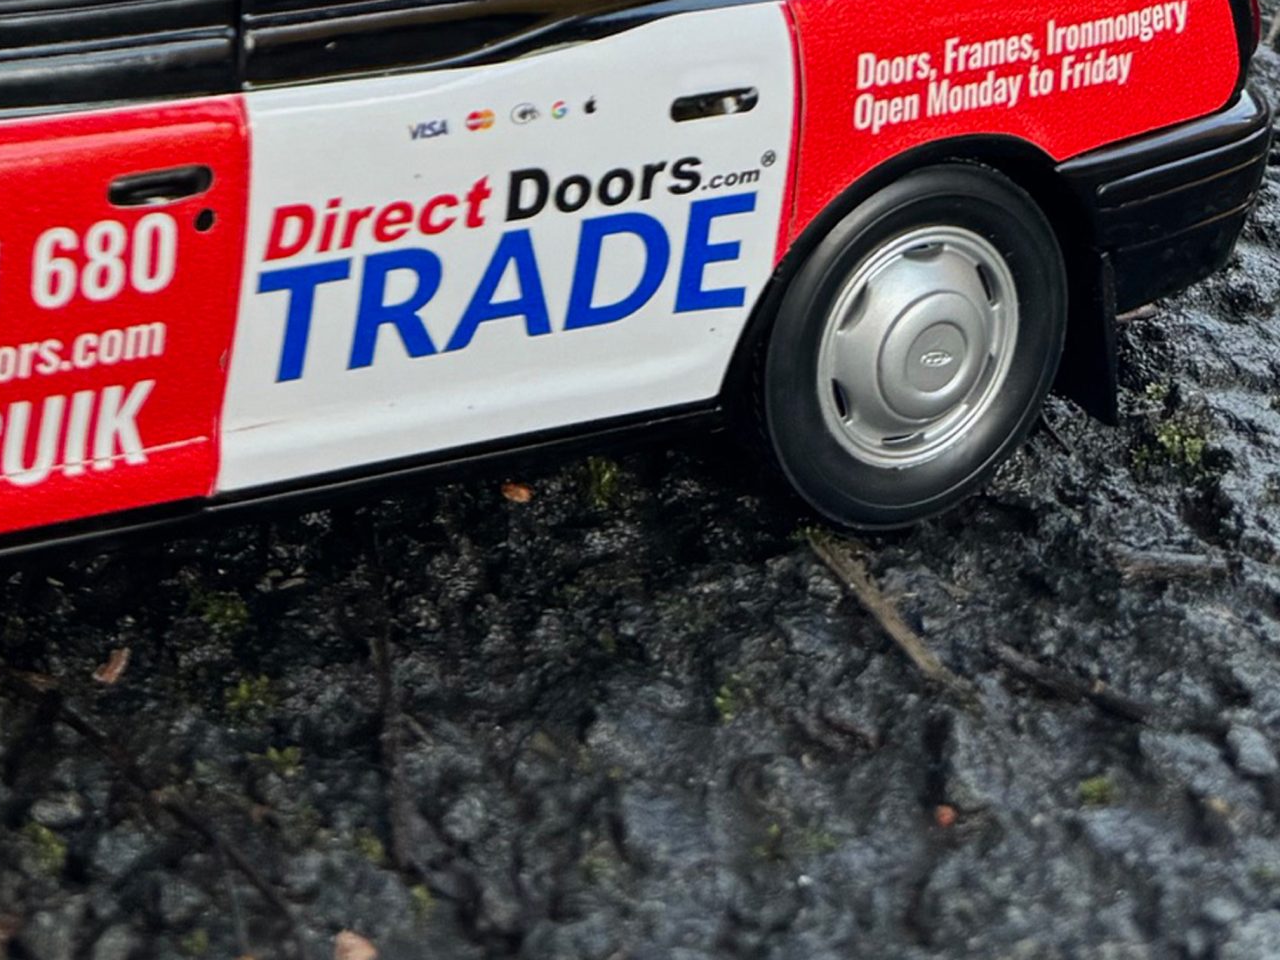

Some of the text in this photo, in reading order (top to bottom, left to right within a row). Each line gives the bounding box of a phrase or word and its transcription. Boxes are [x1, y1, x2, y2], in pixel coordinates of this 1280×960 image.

[856, 0, 1188, 91] Doors, Frames, Ironmongery
[408, 120, 449, 141] VISA
[853, 50, 1133, 134] Open Monday to Friday
[32, 212, 178, 310] 680
[261, 177, 494, 262] Direct
[257, 191, 757, 382] TRADE
